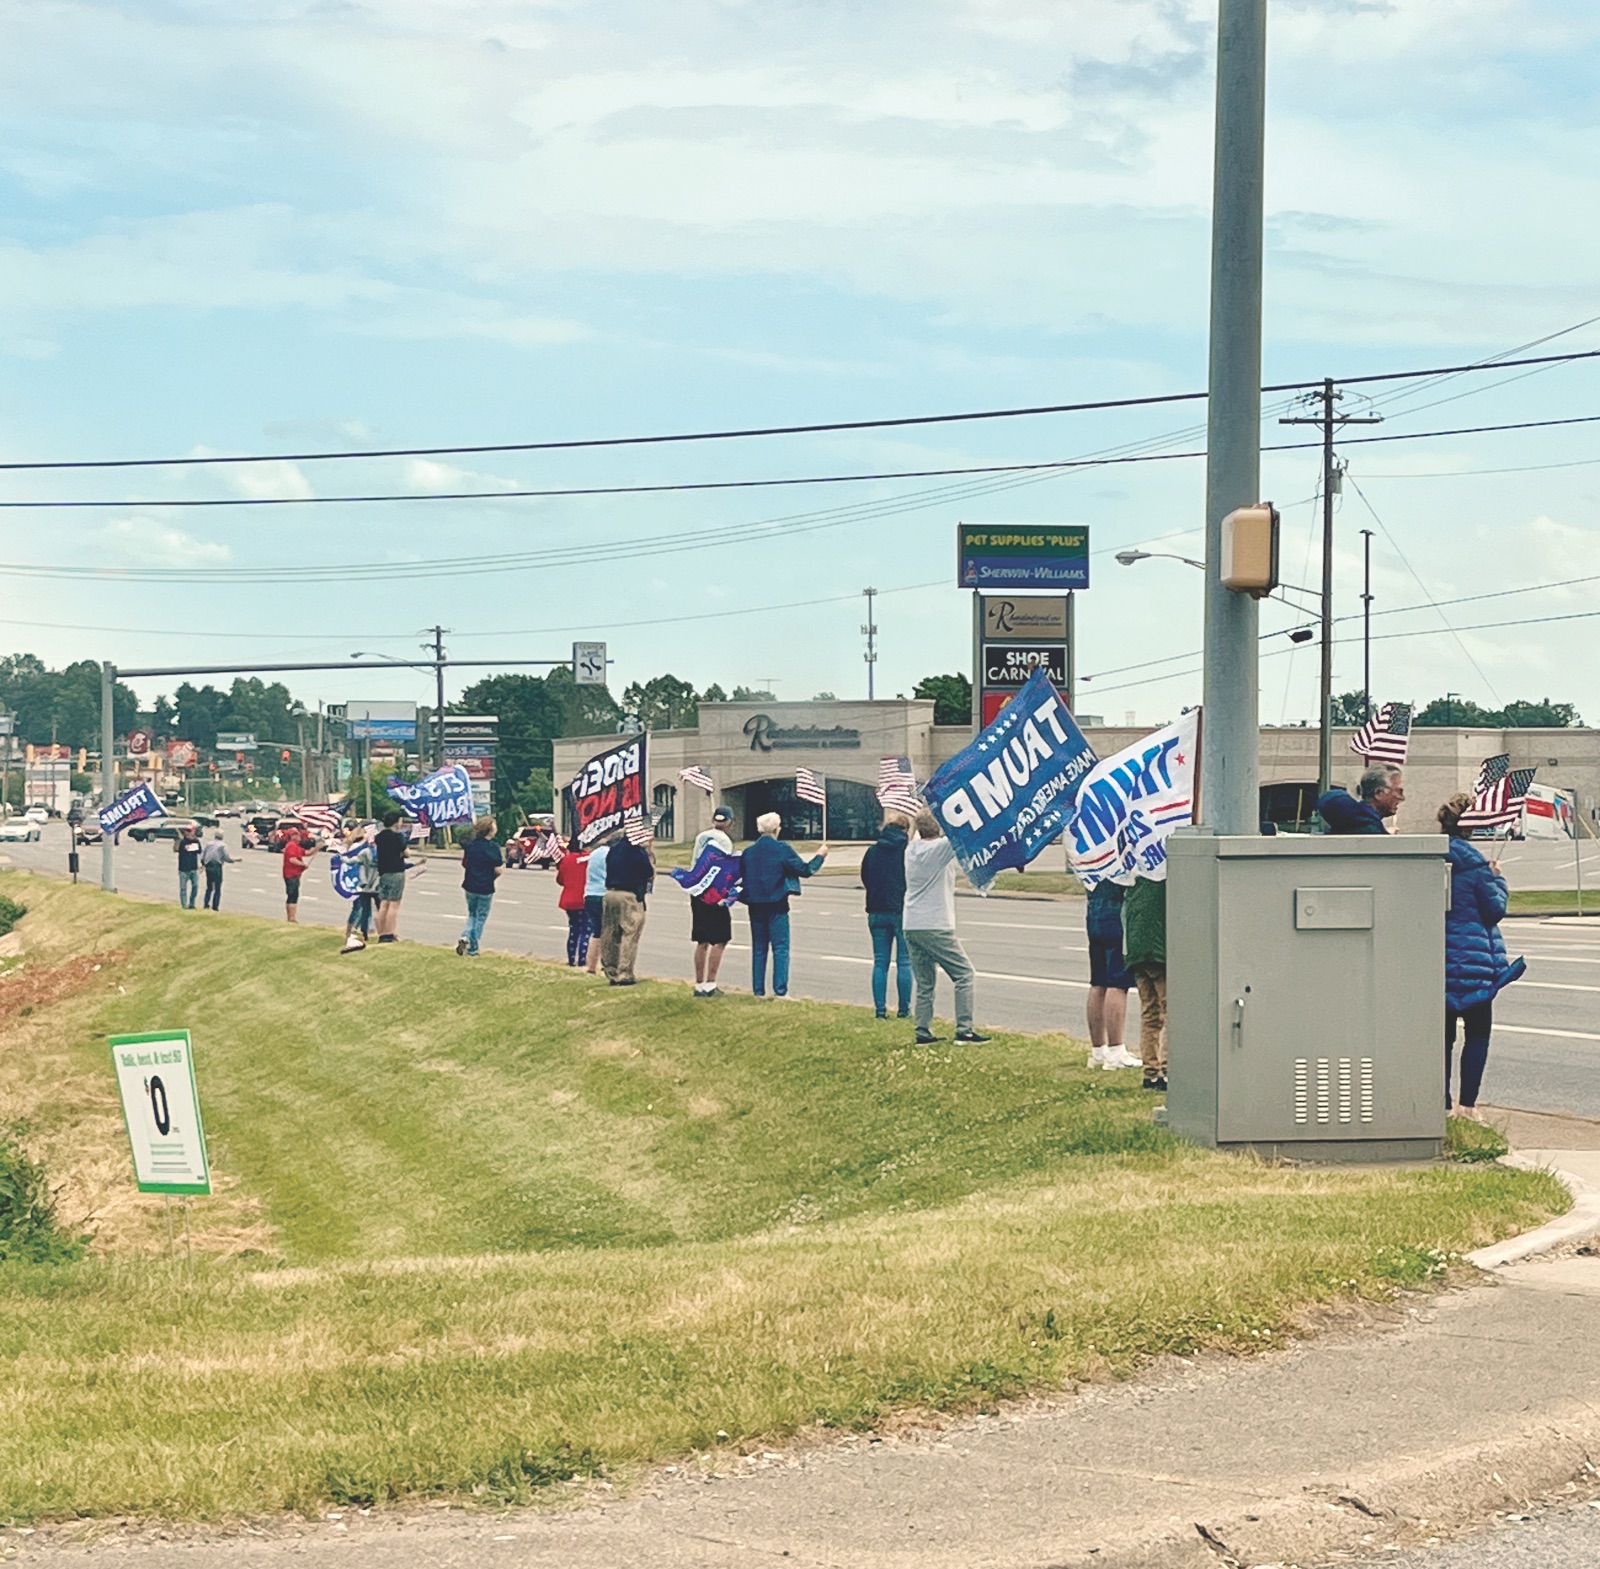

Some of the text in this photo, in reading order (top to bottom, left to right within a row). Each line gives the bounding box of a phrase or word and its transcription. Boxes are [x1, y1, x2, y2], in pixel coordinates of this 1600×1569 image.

[965, 534, 987, 546] PET
[990, 535, 1044, 546] SUPPLIES
[1006, 652, 1050, 665] SHOE
[988, 666, 1064, 680] CARNAL
